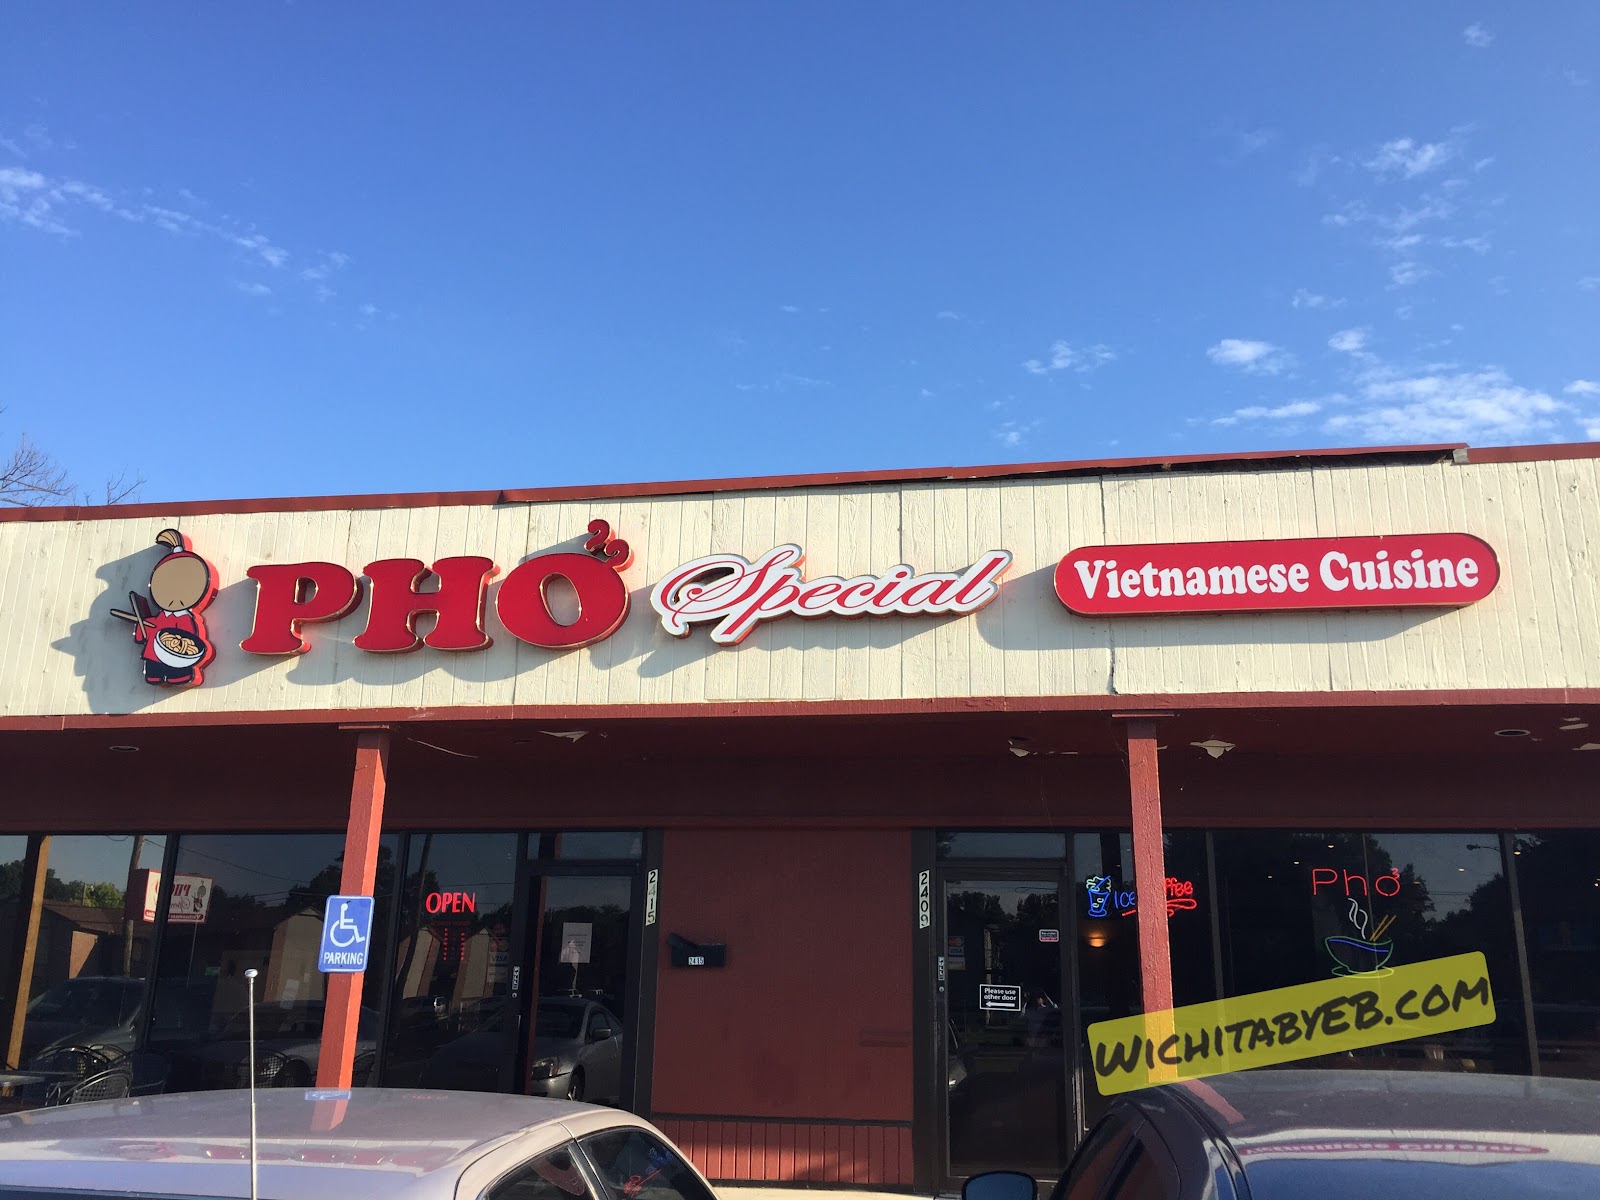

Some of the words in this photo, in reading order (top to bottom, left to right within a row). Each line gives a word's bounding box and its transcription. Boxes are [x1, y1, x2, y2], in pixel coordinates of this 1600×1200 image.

[659, 547, 1007, 638] Special
[1073, 559, 1310, 600] Vietnamese
[1318, 548, 1480, 592] Cuisine
[425, 892, 476, 914] OPEN
[647, 871, 656, 923] 2415
[920, 872, 929, 927] 2409
[1164, 877, 1194, 897] ffee
[323, 951, 364, 965] PARKING
[984, 987, 1004, 995] Please
